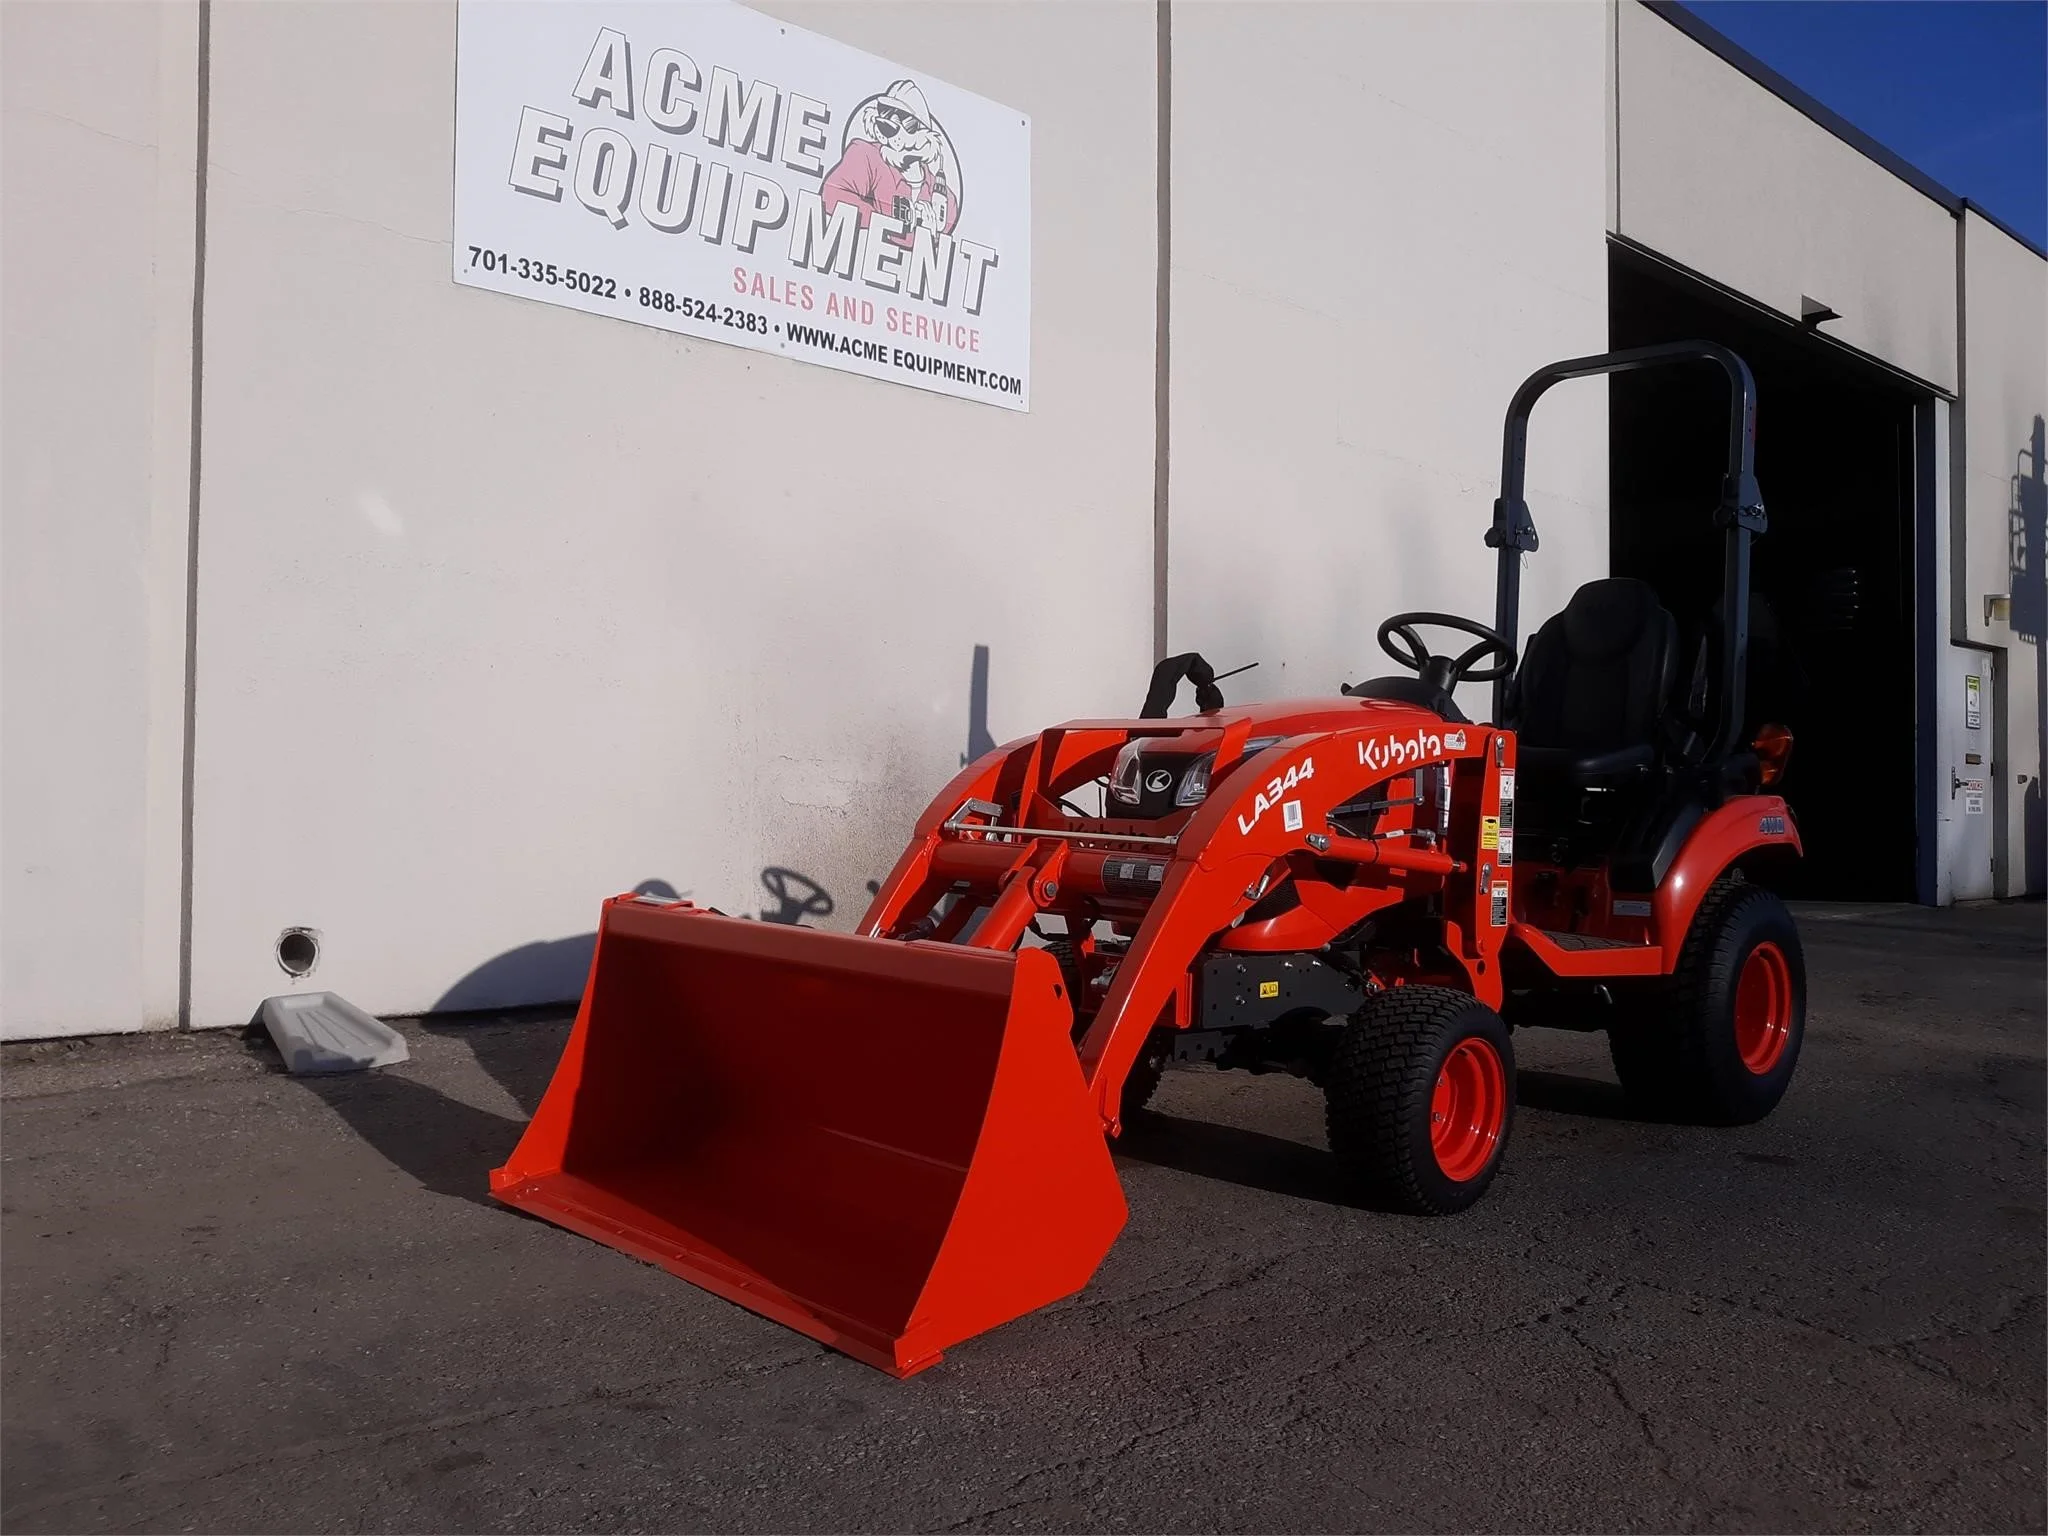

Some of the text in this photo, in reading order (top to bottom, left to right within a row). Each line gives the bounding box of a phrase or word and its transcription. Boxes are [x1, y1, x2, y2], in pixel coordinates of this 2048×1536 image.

[572, 26, 831, 178] ACME
[508, 105, 999, 316] EQUIPMENT
[468, 246, 1022, 396] 701-335-5022 888-524-2383 WWW.ACME EQUIPMENT.COM
[733, 267, 981, 353] SALES AND SERVICE
[1237, 757, 1315, 835] LA344
[1358, 729, 1441, 770] Kubota
